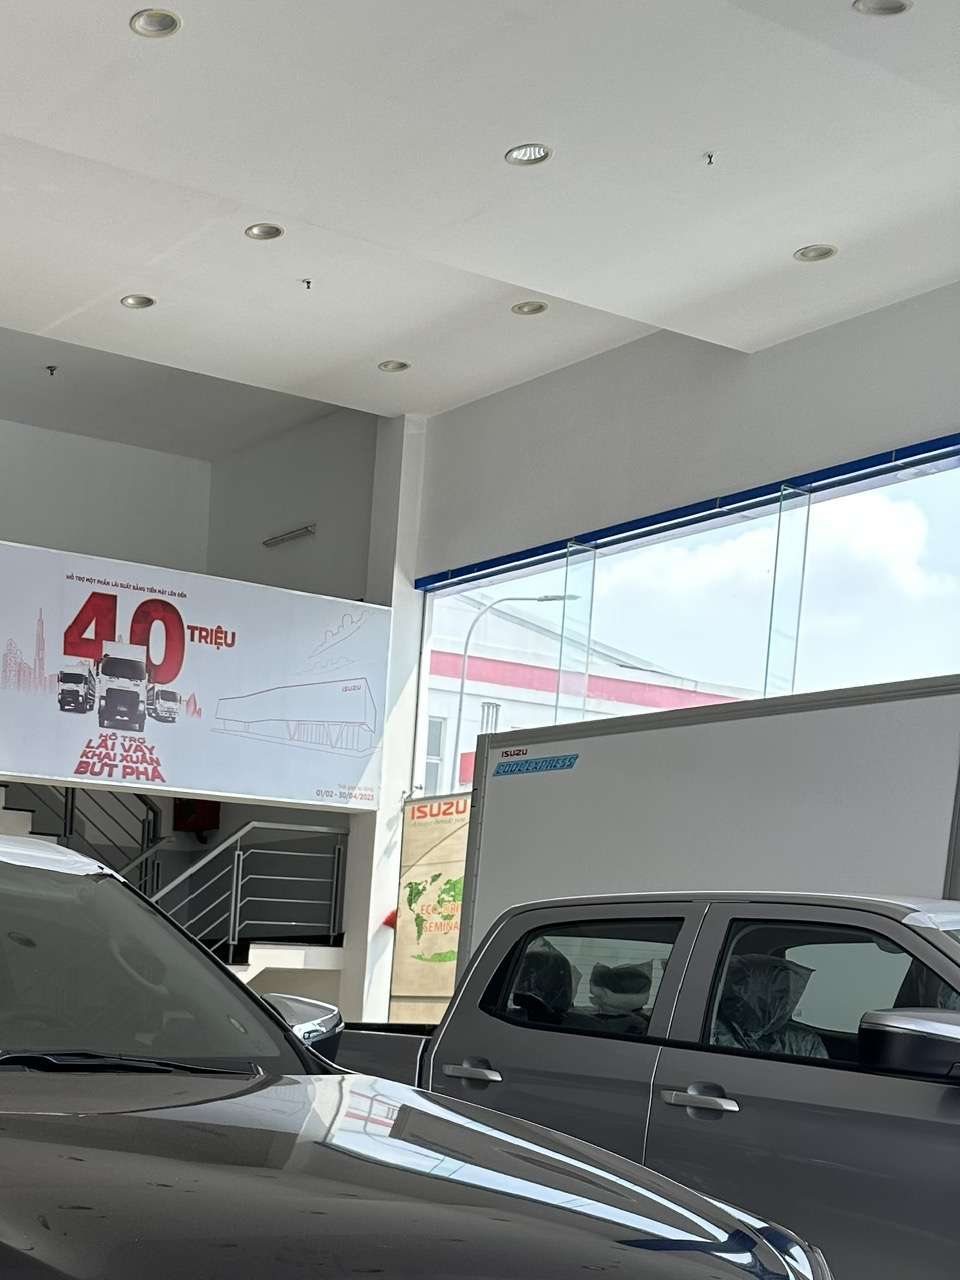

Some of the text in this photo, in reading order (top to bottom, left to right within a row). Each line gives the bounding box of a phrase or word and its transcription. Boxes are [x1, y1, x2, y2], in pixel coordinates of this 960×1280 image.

[64, 592, 236, 684] 40 TRIỆU
[80, 750, 117, 762] KHAI
[501, 749, 528, 758] ISUZU
[411, 799, 467, 820] ISUZU
